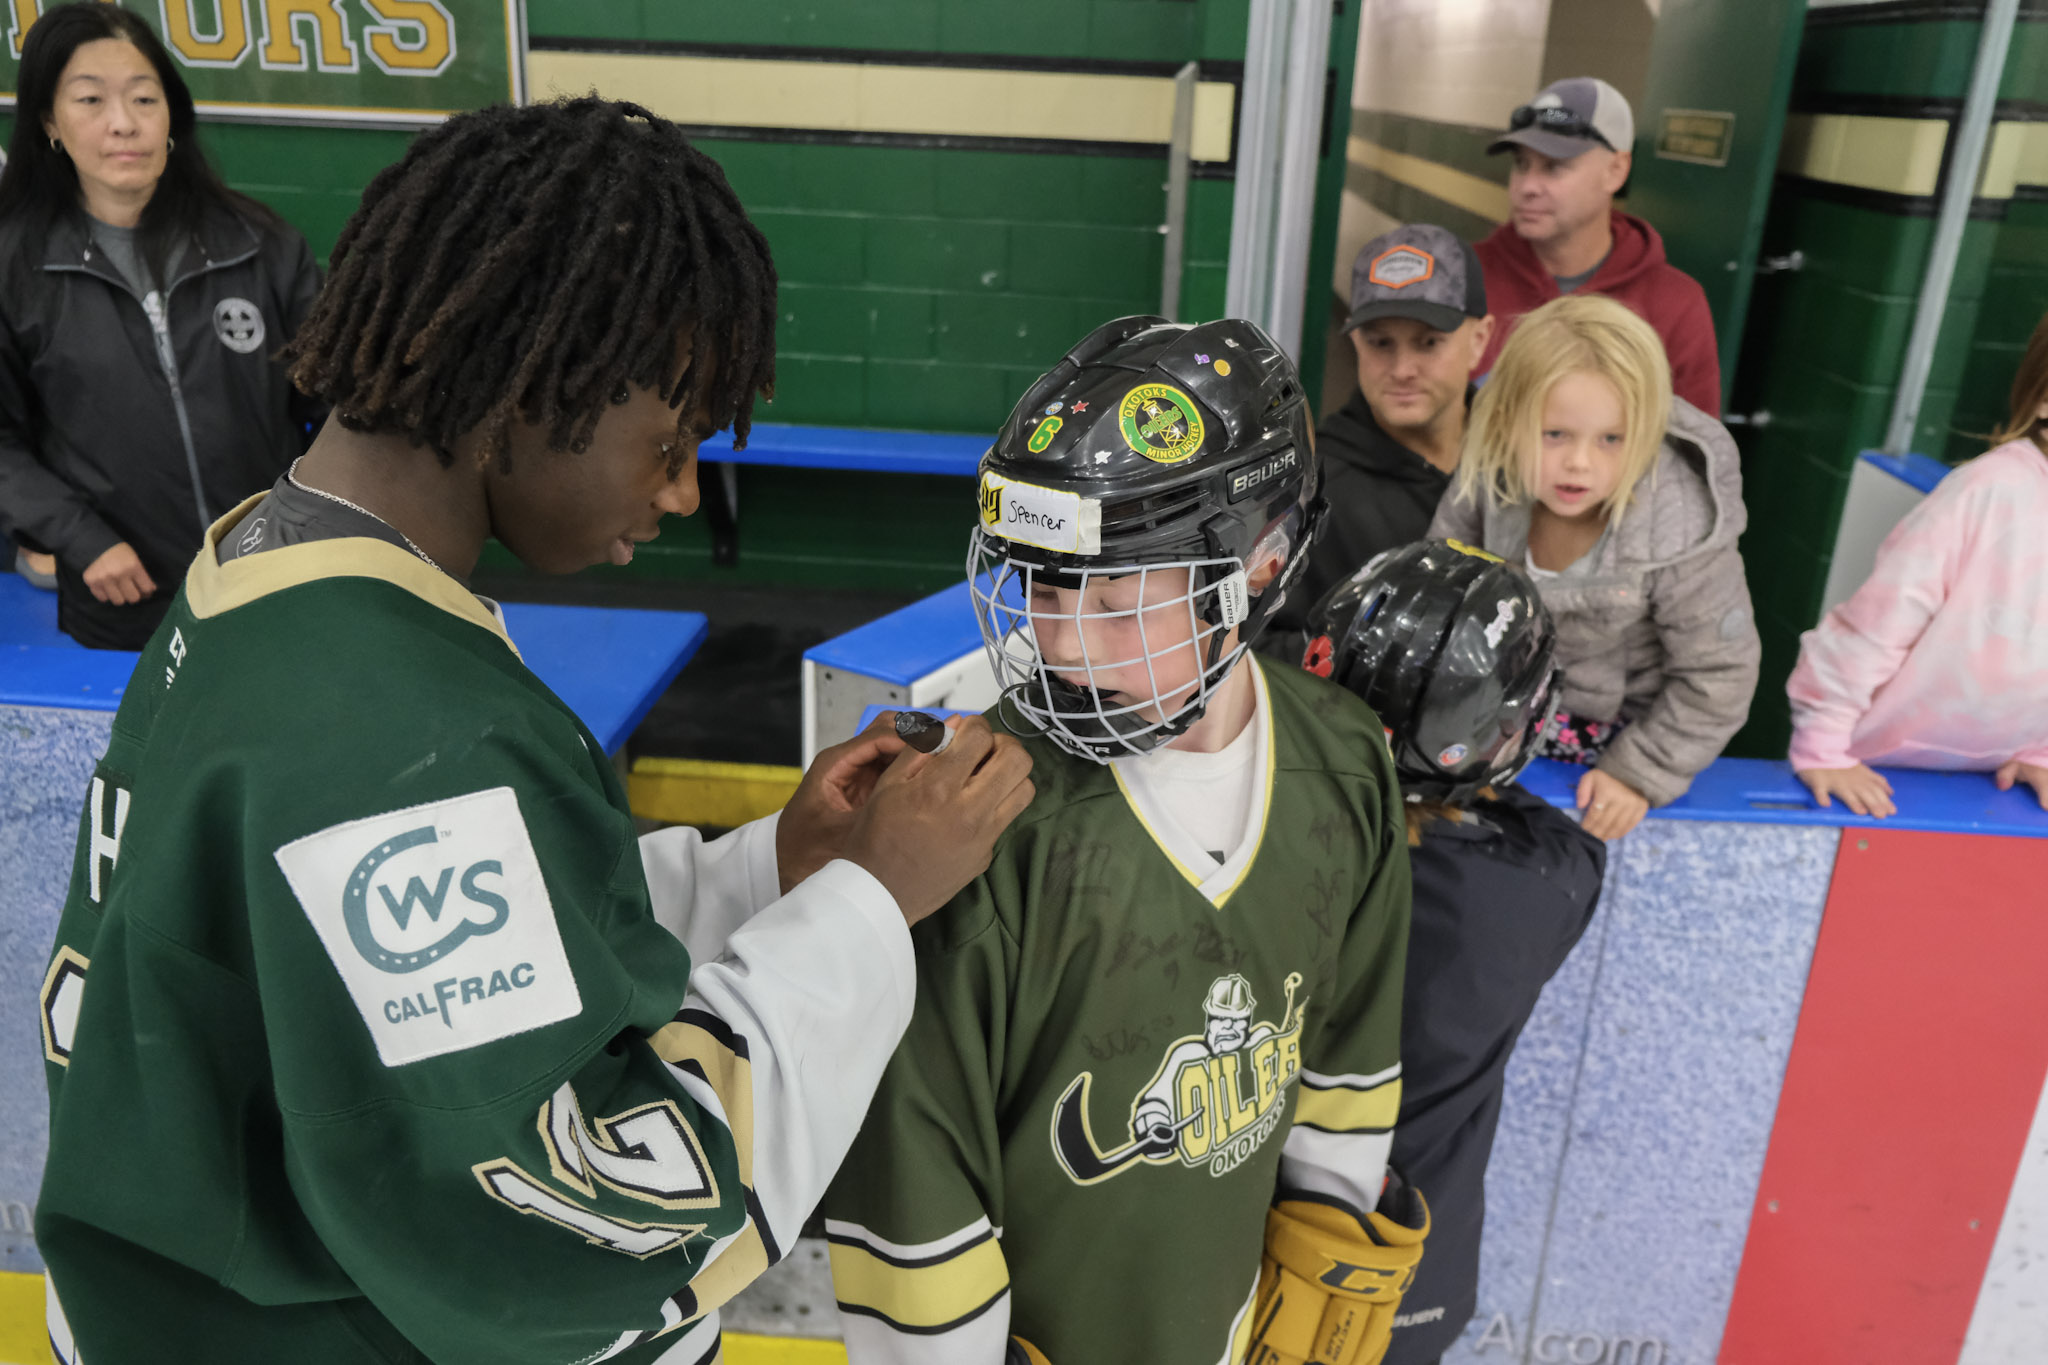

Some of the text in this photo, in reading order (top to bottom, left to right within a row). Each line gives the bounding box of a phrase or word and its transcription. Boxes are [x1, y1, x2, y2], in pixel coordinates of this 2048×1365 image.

[1124, 387, 1167, 418] OKOTOKS
[1140, 405, 1183, 438] OILERS
[1028, 415, 1063, 454] 6
[1145, 421, 1200, 459] MINOR HOCKEY
[1007, 500, 1066, 531] Spencer
[383, 962, 536, 1030] CALFRAC
[1211, 1090, 1286, 1178] OKOTOKS
